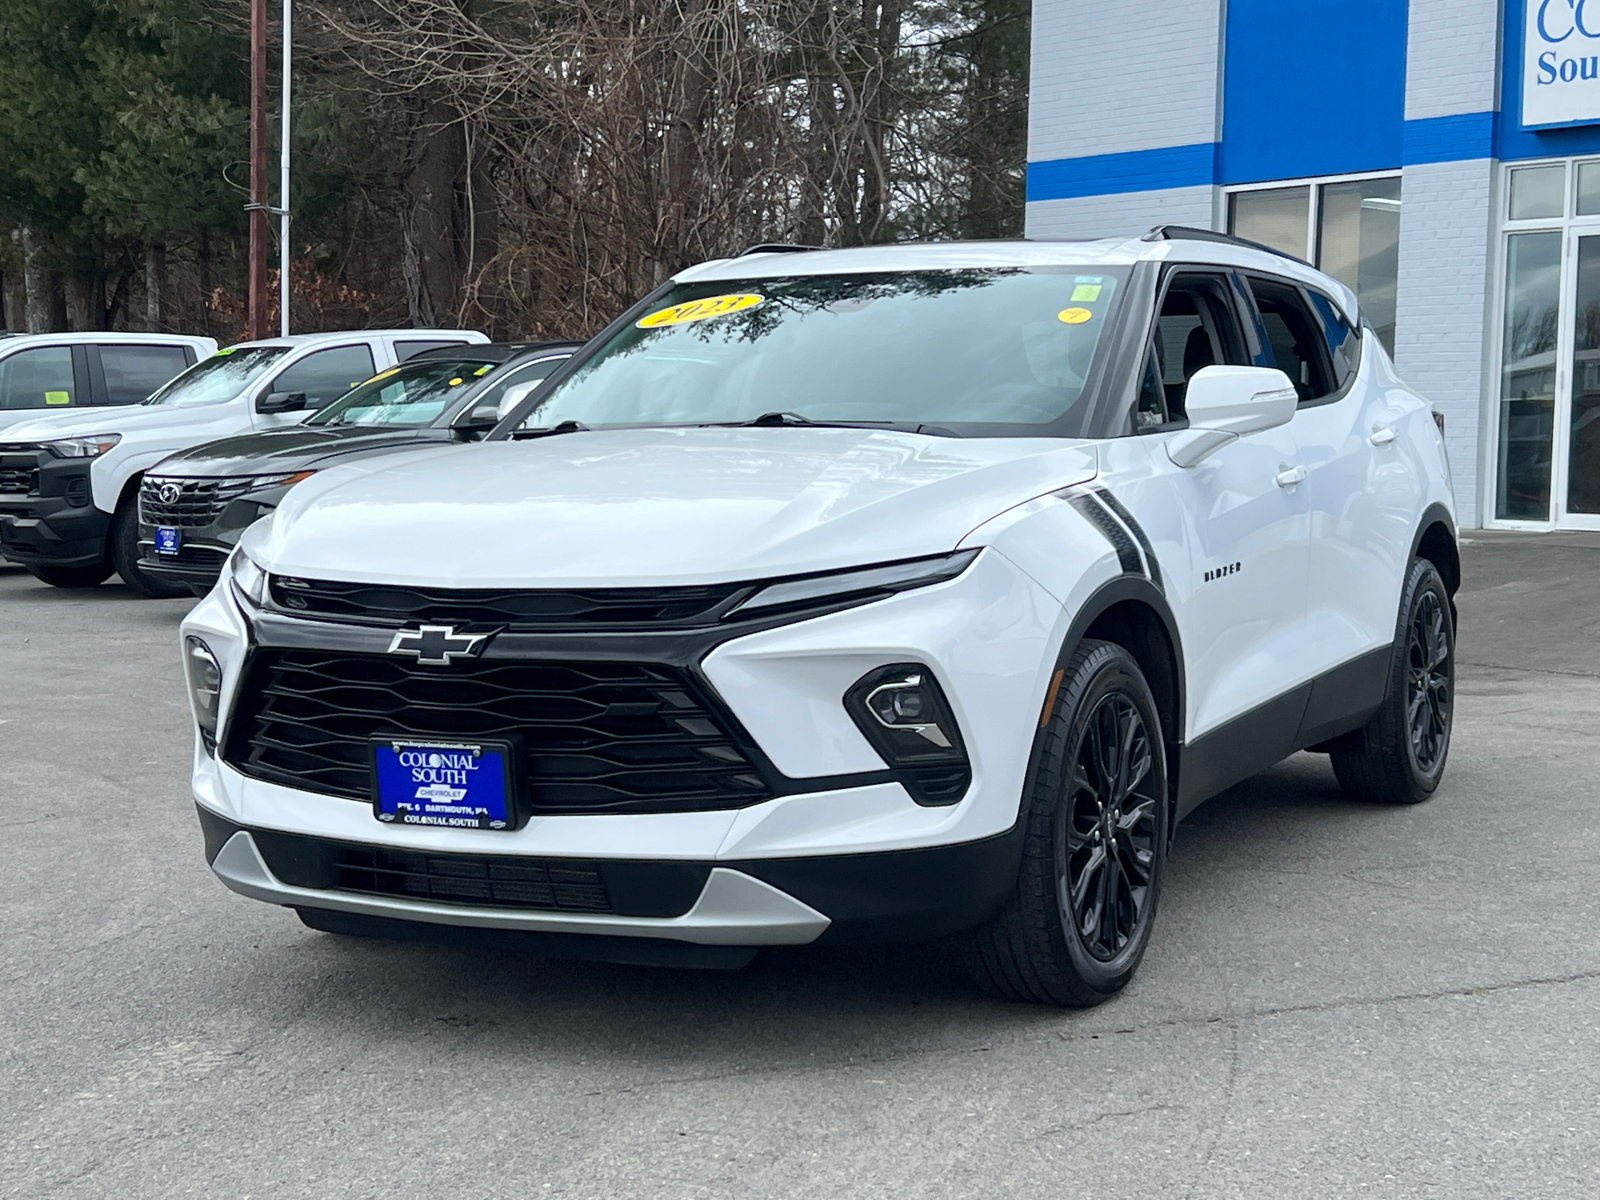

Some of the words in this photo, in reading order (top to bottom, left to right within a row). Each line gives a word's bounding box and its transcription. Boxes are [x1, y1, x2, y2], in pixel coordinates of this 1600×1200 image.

[1204, 561, 1241, 582] BLAZER
[399, 752, 479, 770] COLONIAL
[412, 768, 467, 784] SOUTH
[420, 788, 462, 798] CHEVROLET
[415, 803, 421, 811] 6
[404, 814, 448, 826] COLONIAL
[449, 817, 479, 828] SOUTH
